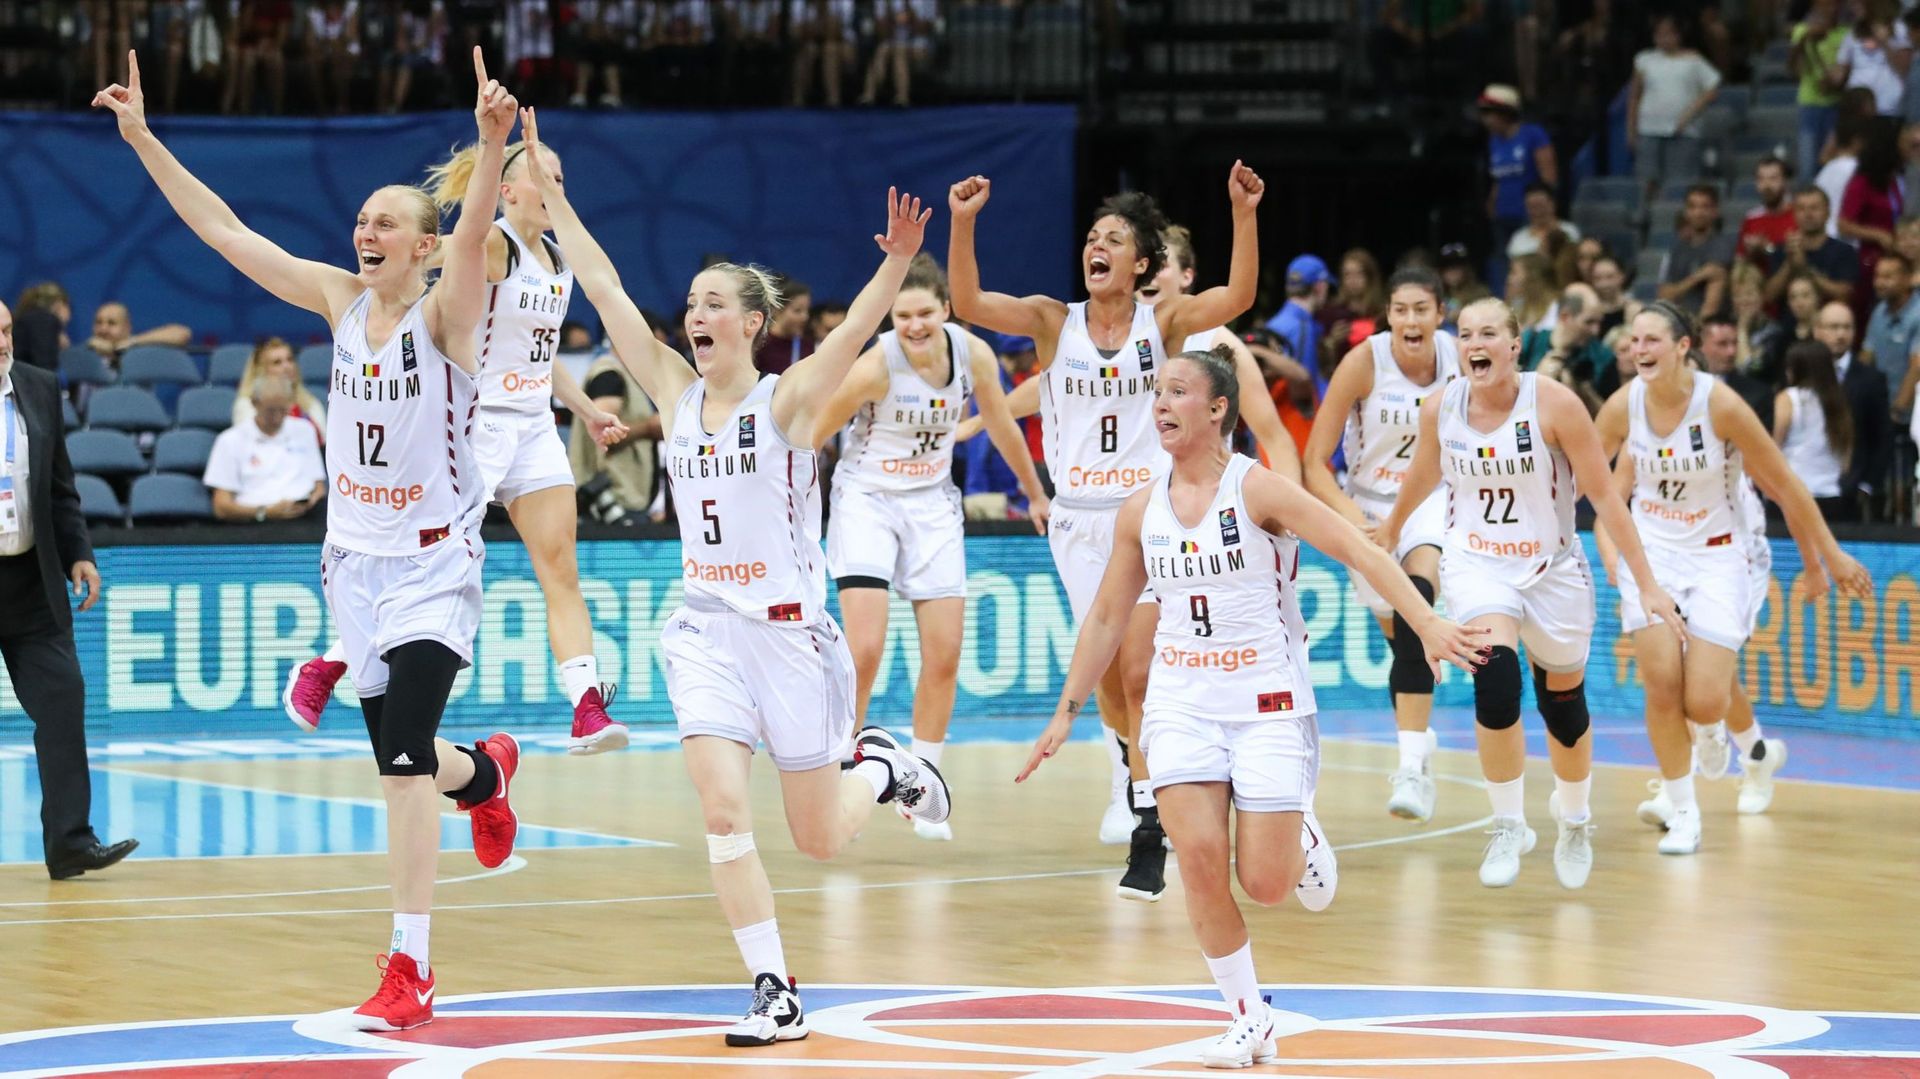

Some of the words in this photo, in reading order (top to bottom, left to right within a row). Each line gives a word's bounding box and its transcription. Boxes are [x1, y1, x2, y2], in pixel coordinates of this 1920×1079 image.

[530, 328, 557, 363] 35
[335, 368, 421, 402] BELGIUM
[1065, 373, 1155, 398] BELGIUM
[356, 421, 389, 467] 12
[1100, 414, 1118, 453] 8
[336, 472, 424, 511] Orange
[1068, 465, 1152, 488] Orange
[701, 499, 722, 545] 5
[1479, 487, 1519, 525] 22
[1467, 531, 1541, 558] Orange
[683, 558, 768, 586] Orange
[1150, 548, 1245, 579] BELGIUM
[1189, 594, 1213, 638] 9
[1160, 643, 1259, 672] Orange
